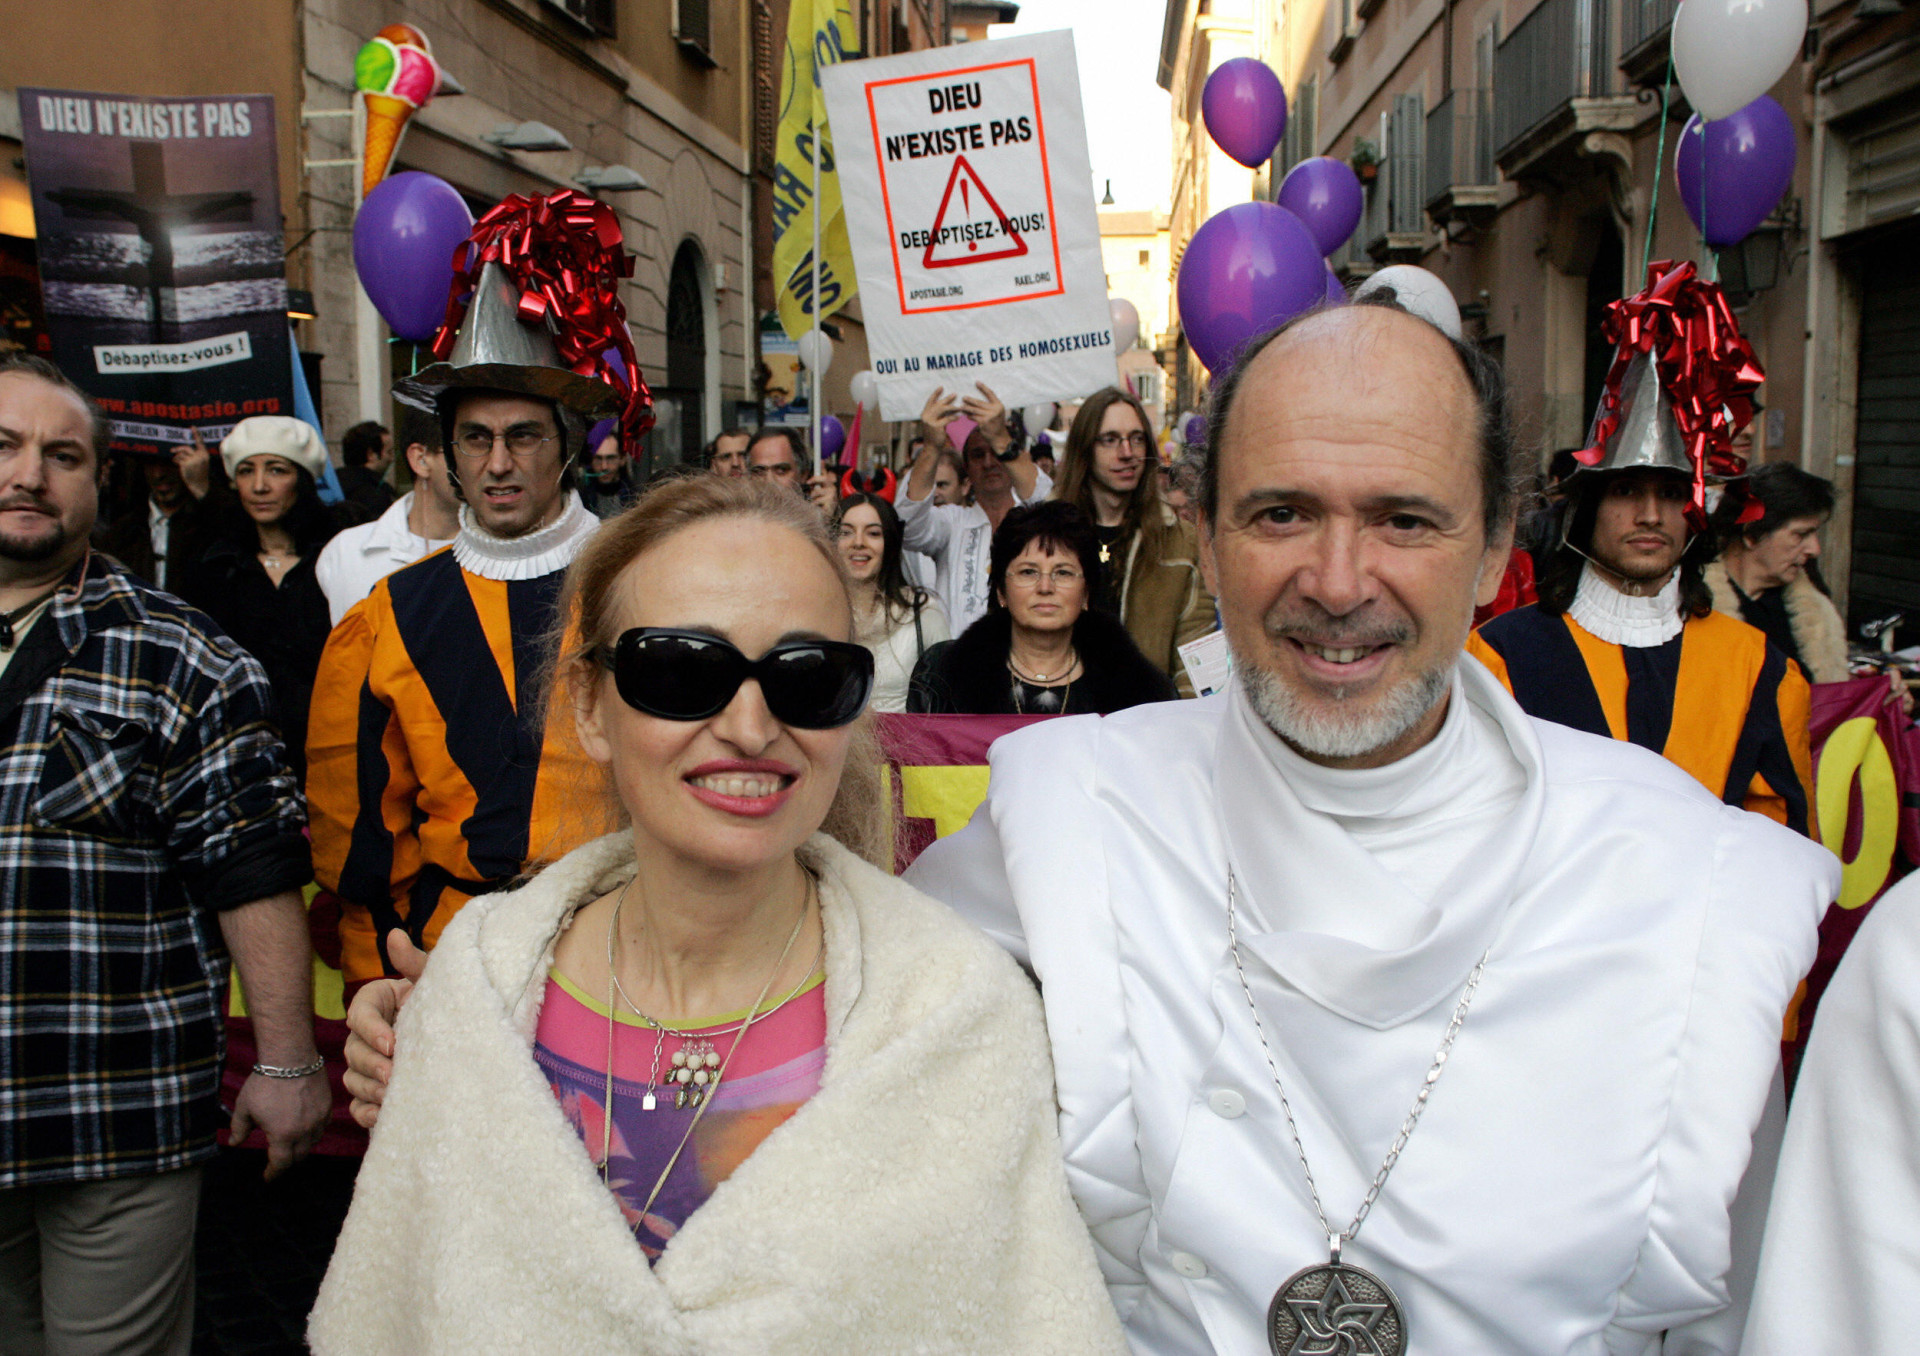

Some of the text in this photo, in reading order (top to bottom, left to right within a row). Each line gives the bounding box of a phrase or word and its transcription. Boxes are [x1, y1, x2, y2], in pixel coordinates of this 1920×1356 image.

[928, 81, 982, 114] DIEU
[37, 95, 252, 139] DIEU N'EXISTE PAS
[886, 116, 1032, 162] N'EXISTE PAS
[901, 213, 1046, 249] DEBAPTISEZ-VOUS!
[909, 285, 964, 300] APOSTASIE.ORG
[1015, 271, 1051, 287] RAEL.ORG
[876, 330, 1111, 375] OUI AU MARIAGE DES HOMOSEXUELS
[95, 397, 280, 420] ww.apostasie.org
